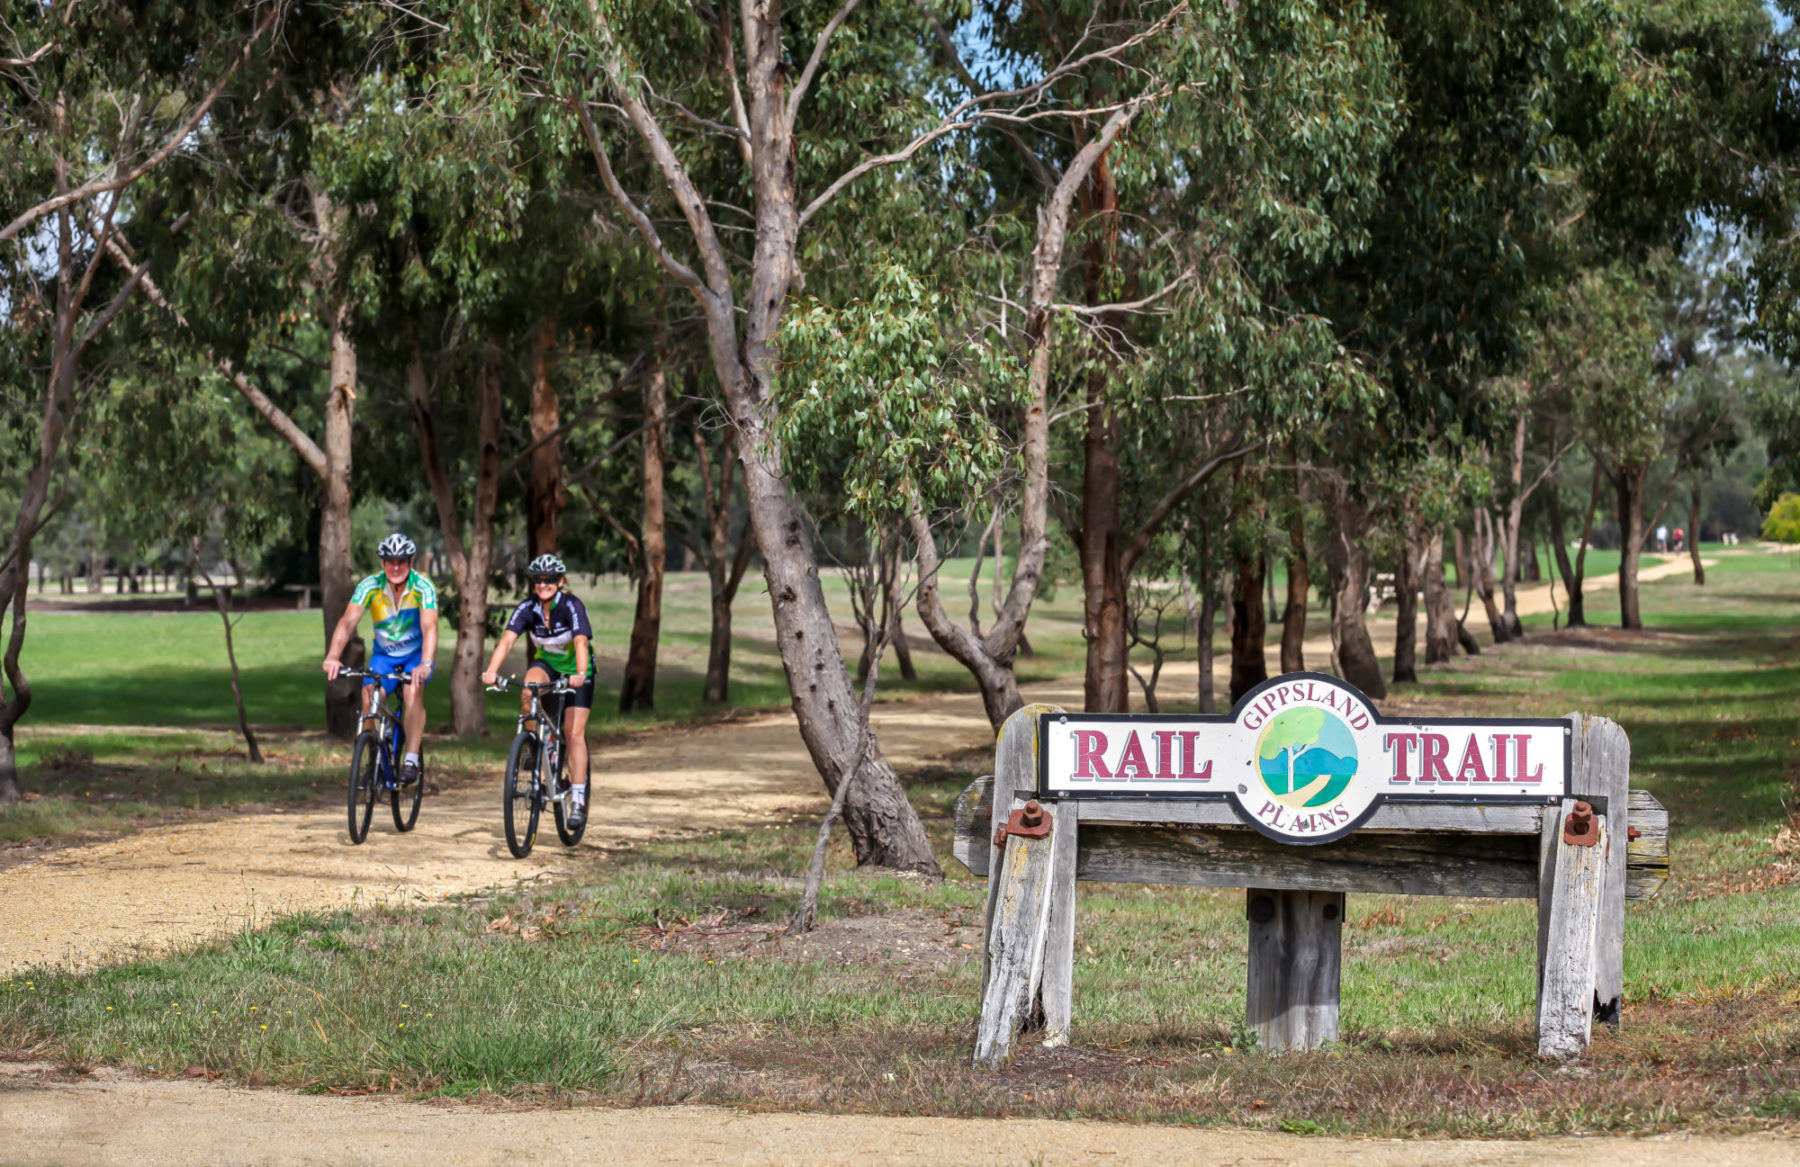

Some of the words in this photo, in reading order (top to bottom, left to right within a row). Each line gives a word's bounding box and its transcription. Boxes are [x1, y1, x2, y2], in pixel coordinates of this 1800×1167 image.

[1243, 682, 1370, 731] GIPPSLAND
[1071, 729, 1213, 781] RAIL
[1384, 732, 1544, 785] TRAIL
[1257, 800, 1350, 833] PLAINS
